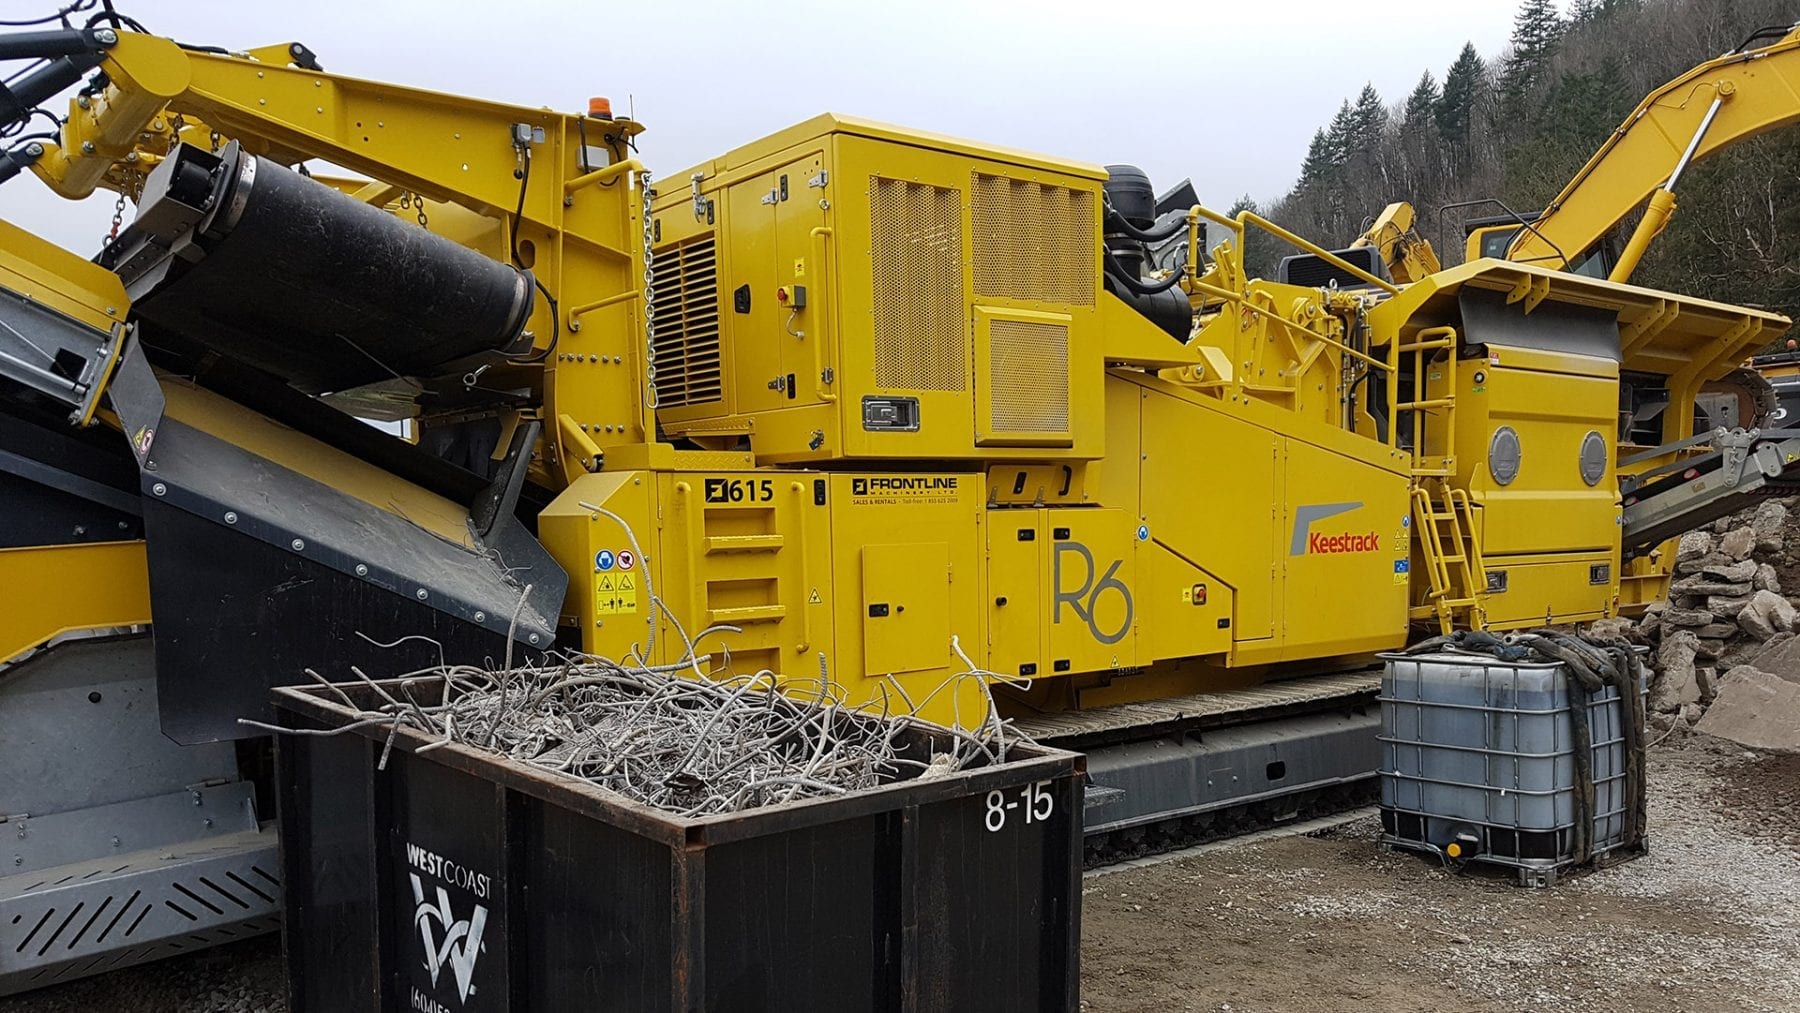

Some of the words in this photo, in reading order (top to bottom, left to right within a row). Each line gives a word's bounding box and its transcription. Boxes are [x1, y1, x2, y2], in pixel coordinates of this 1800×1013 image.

[729, 480, 773, 502] 615
[870, 478, 957, 489] FRONTLINE
[1309, 531, 1379, 554] Keestrack
[1053, 541, 1133, 645] R6
[985, 779, 1054, 833] 8-15
